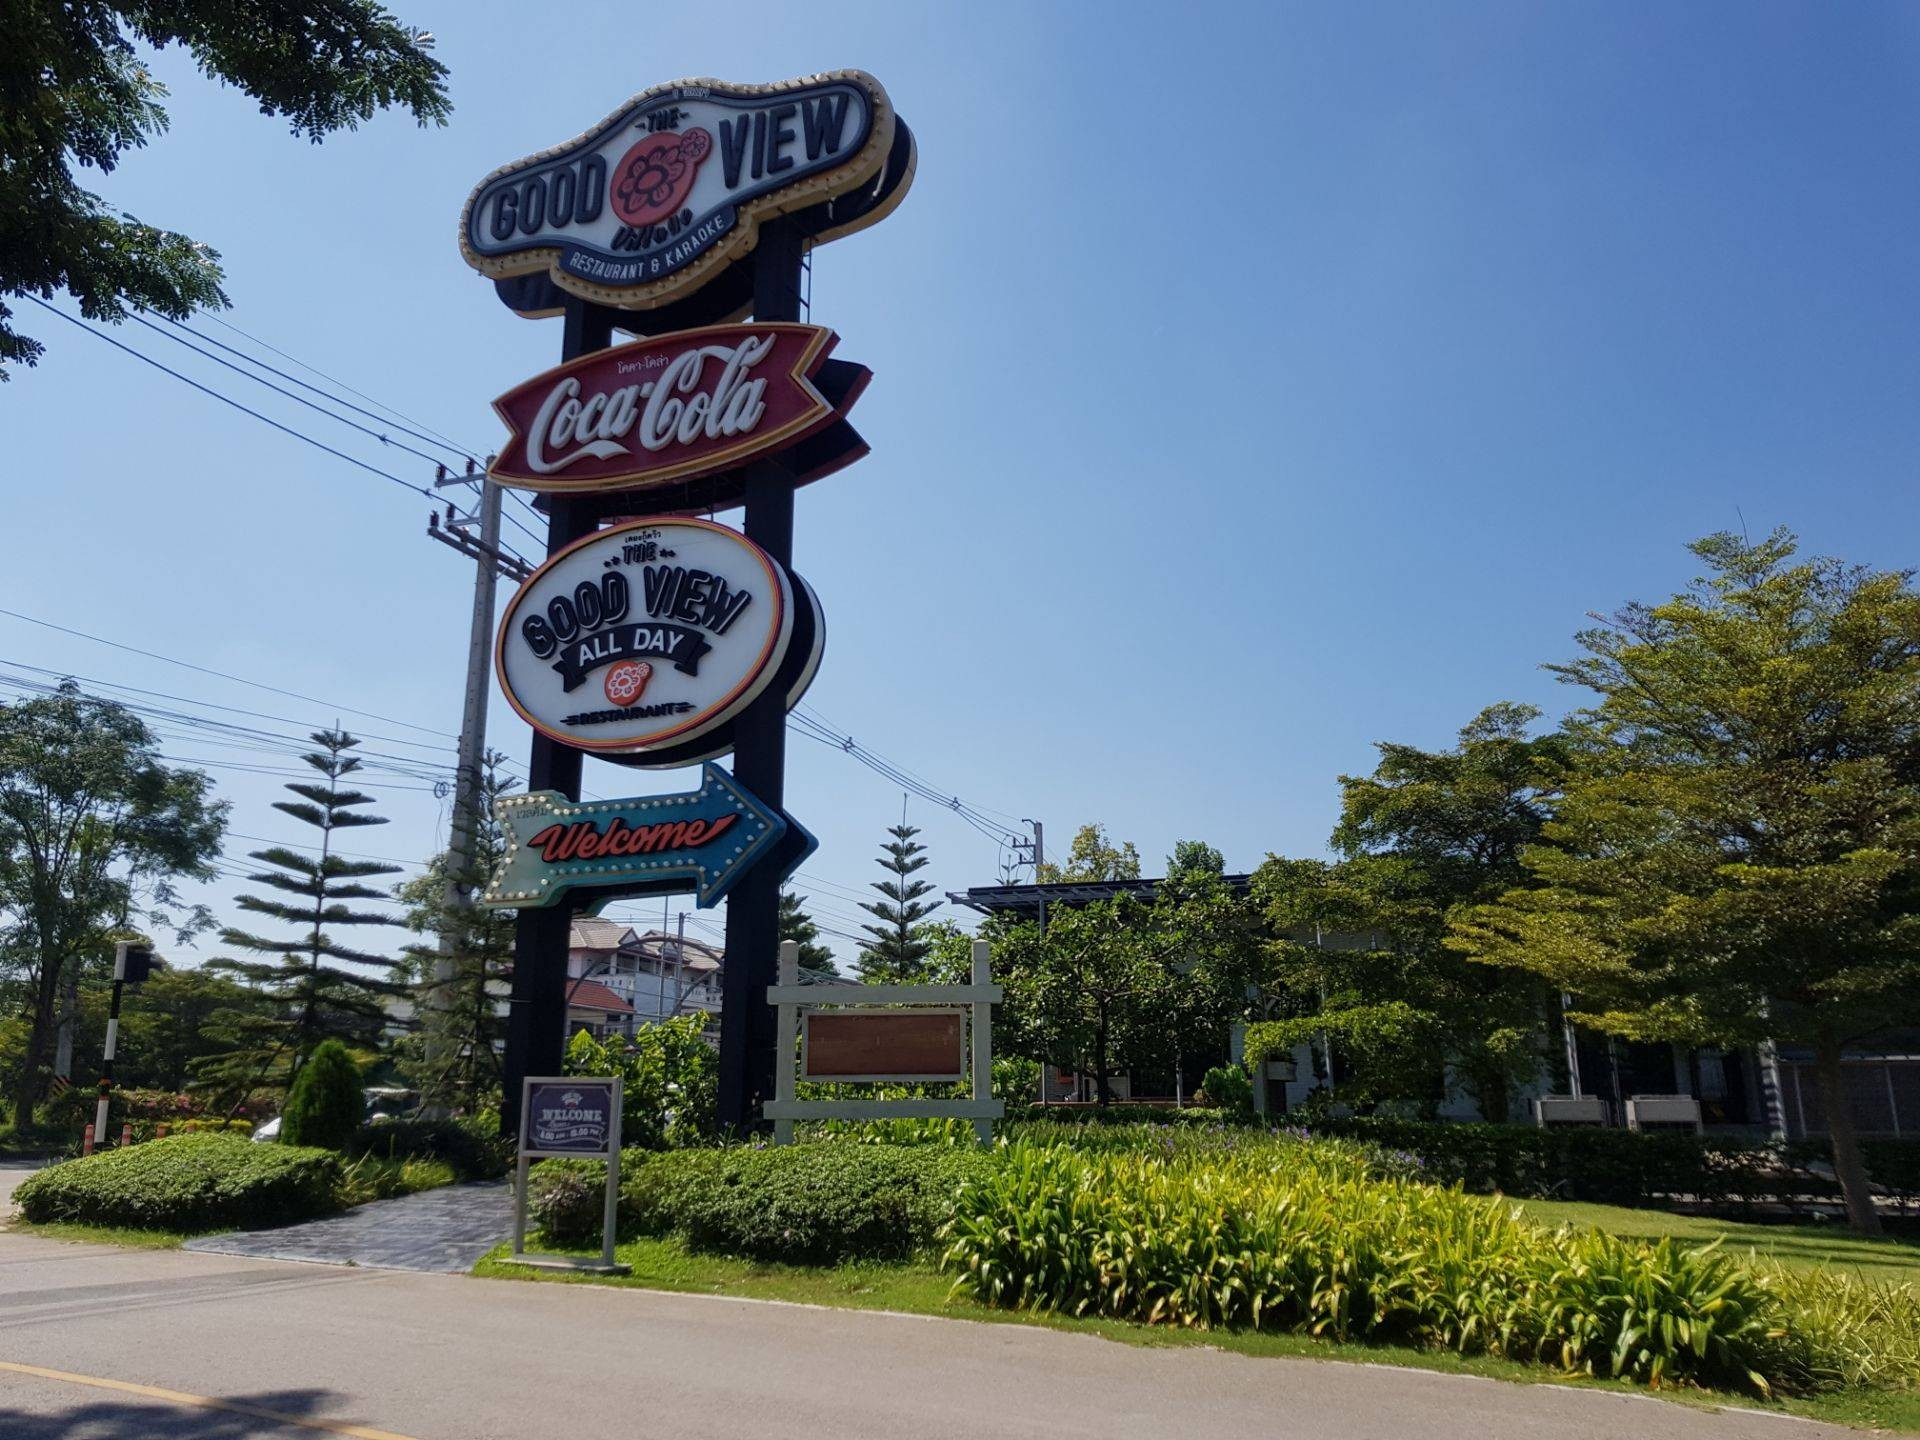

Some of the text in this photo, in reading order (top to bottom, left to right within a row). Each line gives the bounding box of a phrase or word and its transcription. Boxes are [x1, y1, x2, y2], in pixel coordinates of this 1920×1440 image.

[646, 106, 680, 133] THE
[489, 94, 850, 241] GOOD VIEW
[569, 214, 725, 280] RESTAURANT & KARAOKE
[622, 541, 657, 565] THE
[522, 565, 752, 660] GOOD VIEW
[578, 628, 684, 666] ALL DAY
[579, 703, 676, 724] RESTAURANT
[527, 813, 741, 863] Welcome
[542, 1108, 603, 1122] WELCOME
